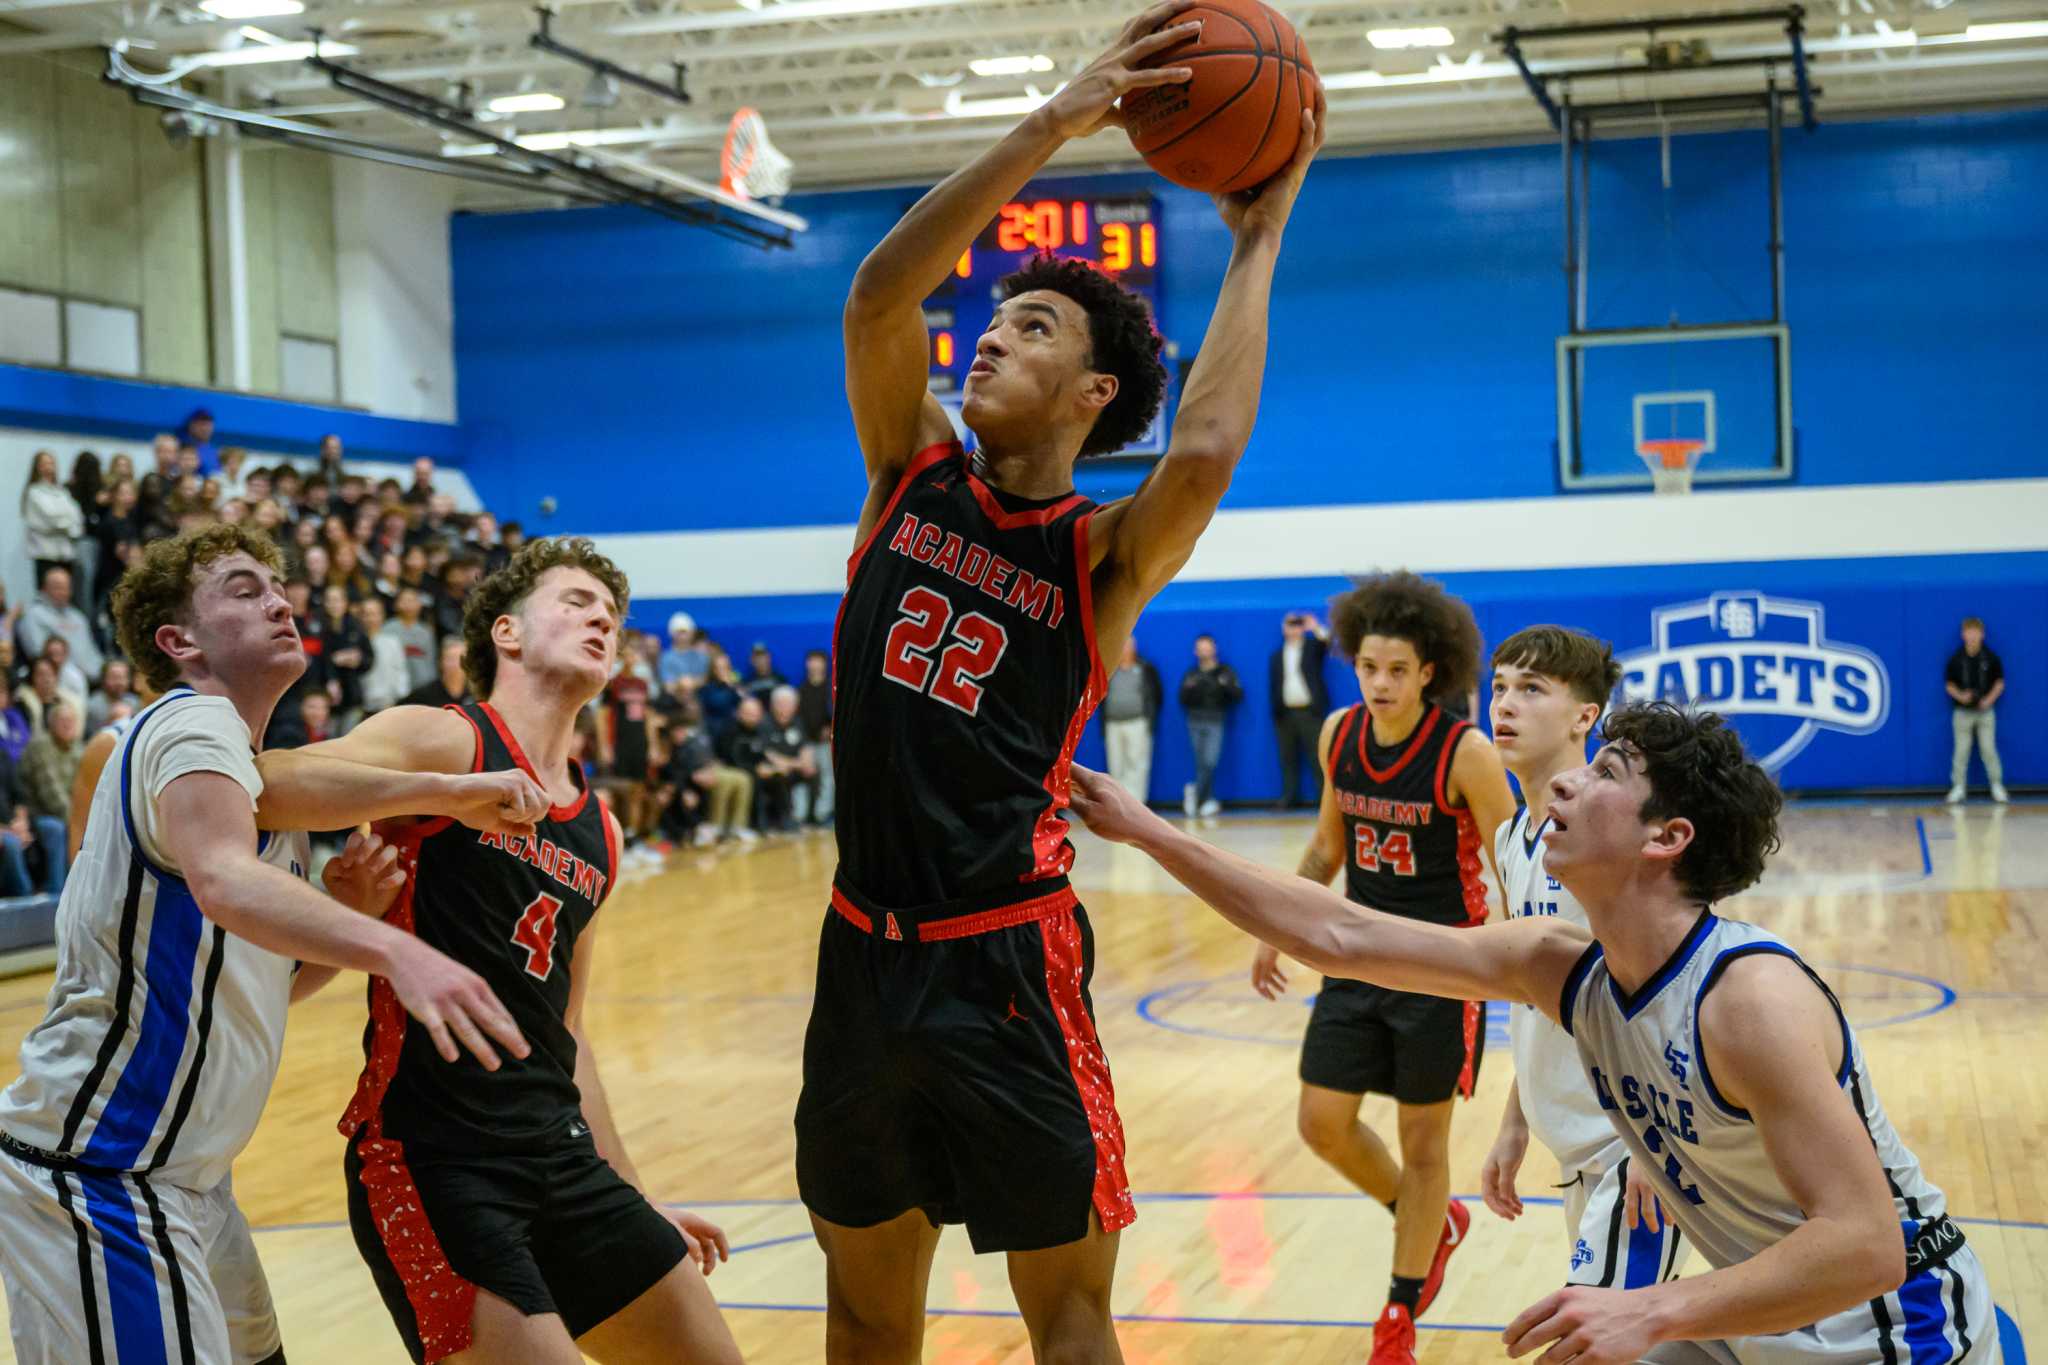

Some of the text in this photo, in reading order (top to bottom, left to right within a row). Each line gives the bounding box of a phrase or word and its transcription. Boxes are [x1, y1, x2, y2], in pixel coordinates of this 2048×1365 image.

[998, 199, 1088, 252] 2:01
[1102, 222, 1157, 270] 31
[889, 512, 1065, 629] ACADEMY
[882, 585, 1009, 718] 22
[1355, 823, 1416, 876] 24
[510, 890, 564, 982] 4
